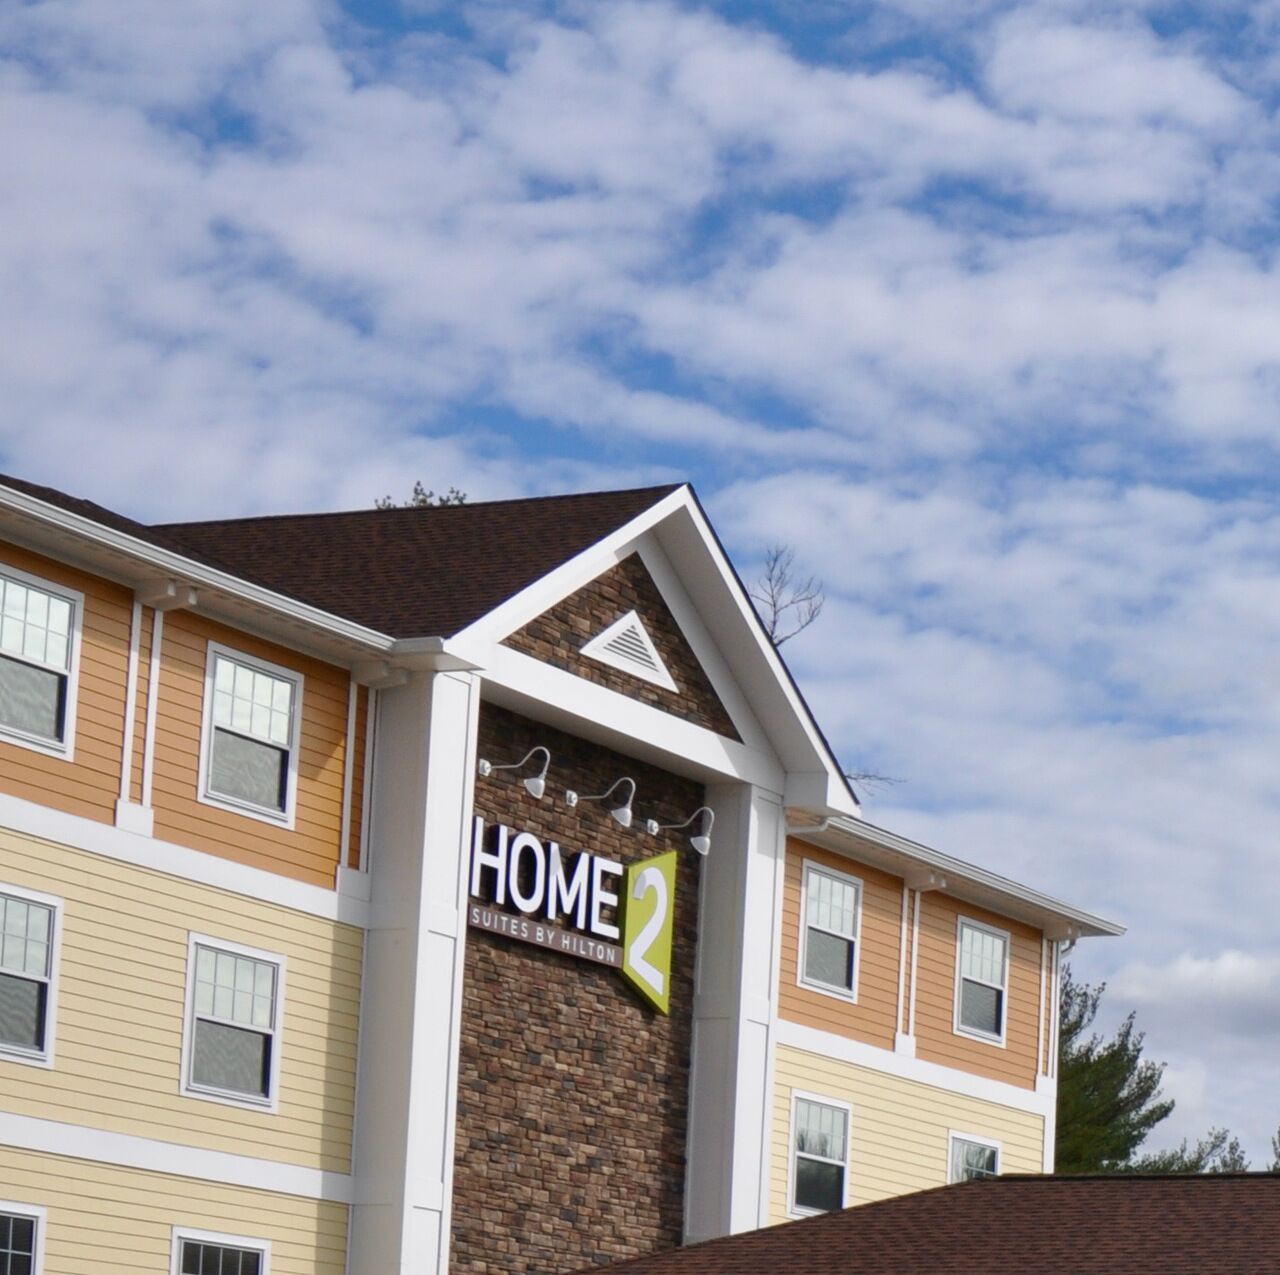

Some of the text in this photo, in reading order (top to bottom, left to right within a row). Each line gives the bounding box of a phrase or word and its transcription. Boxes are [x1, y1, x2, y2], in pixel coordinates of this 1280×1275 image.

[472, 909, 616, 963] SUITES BY HILTON
